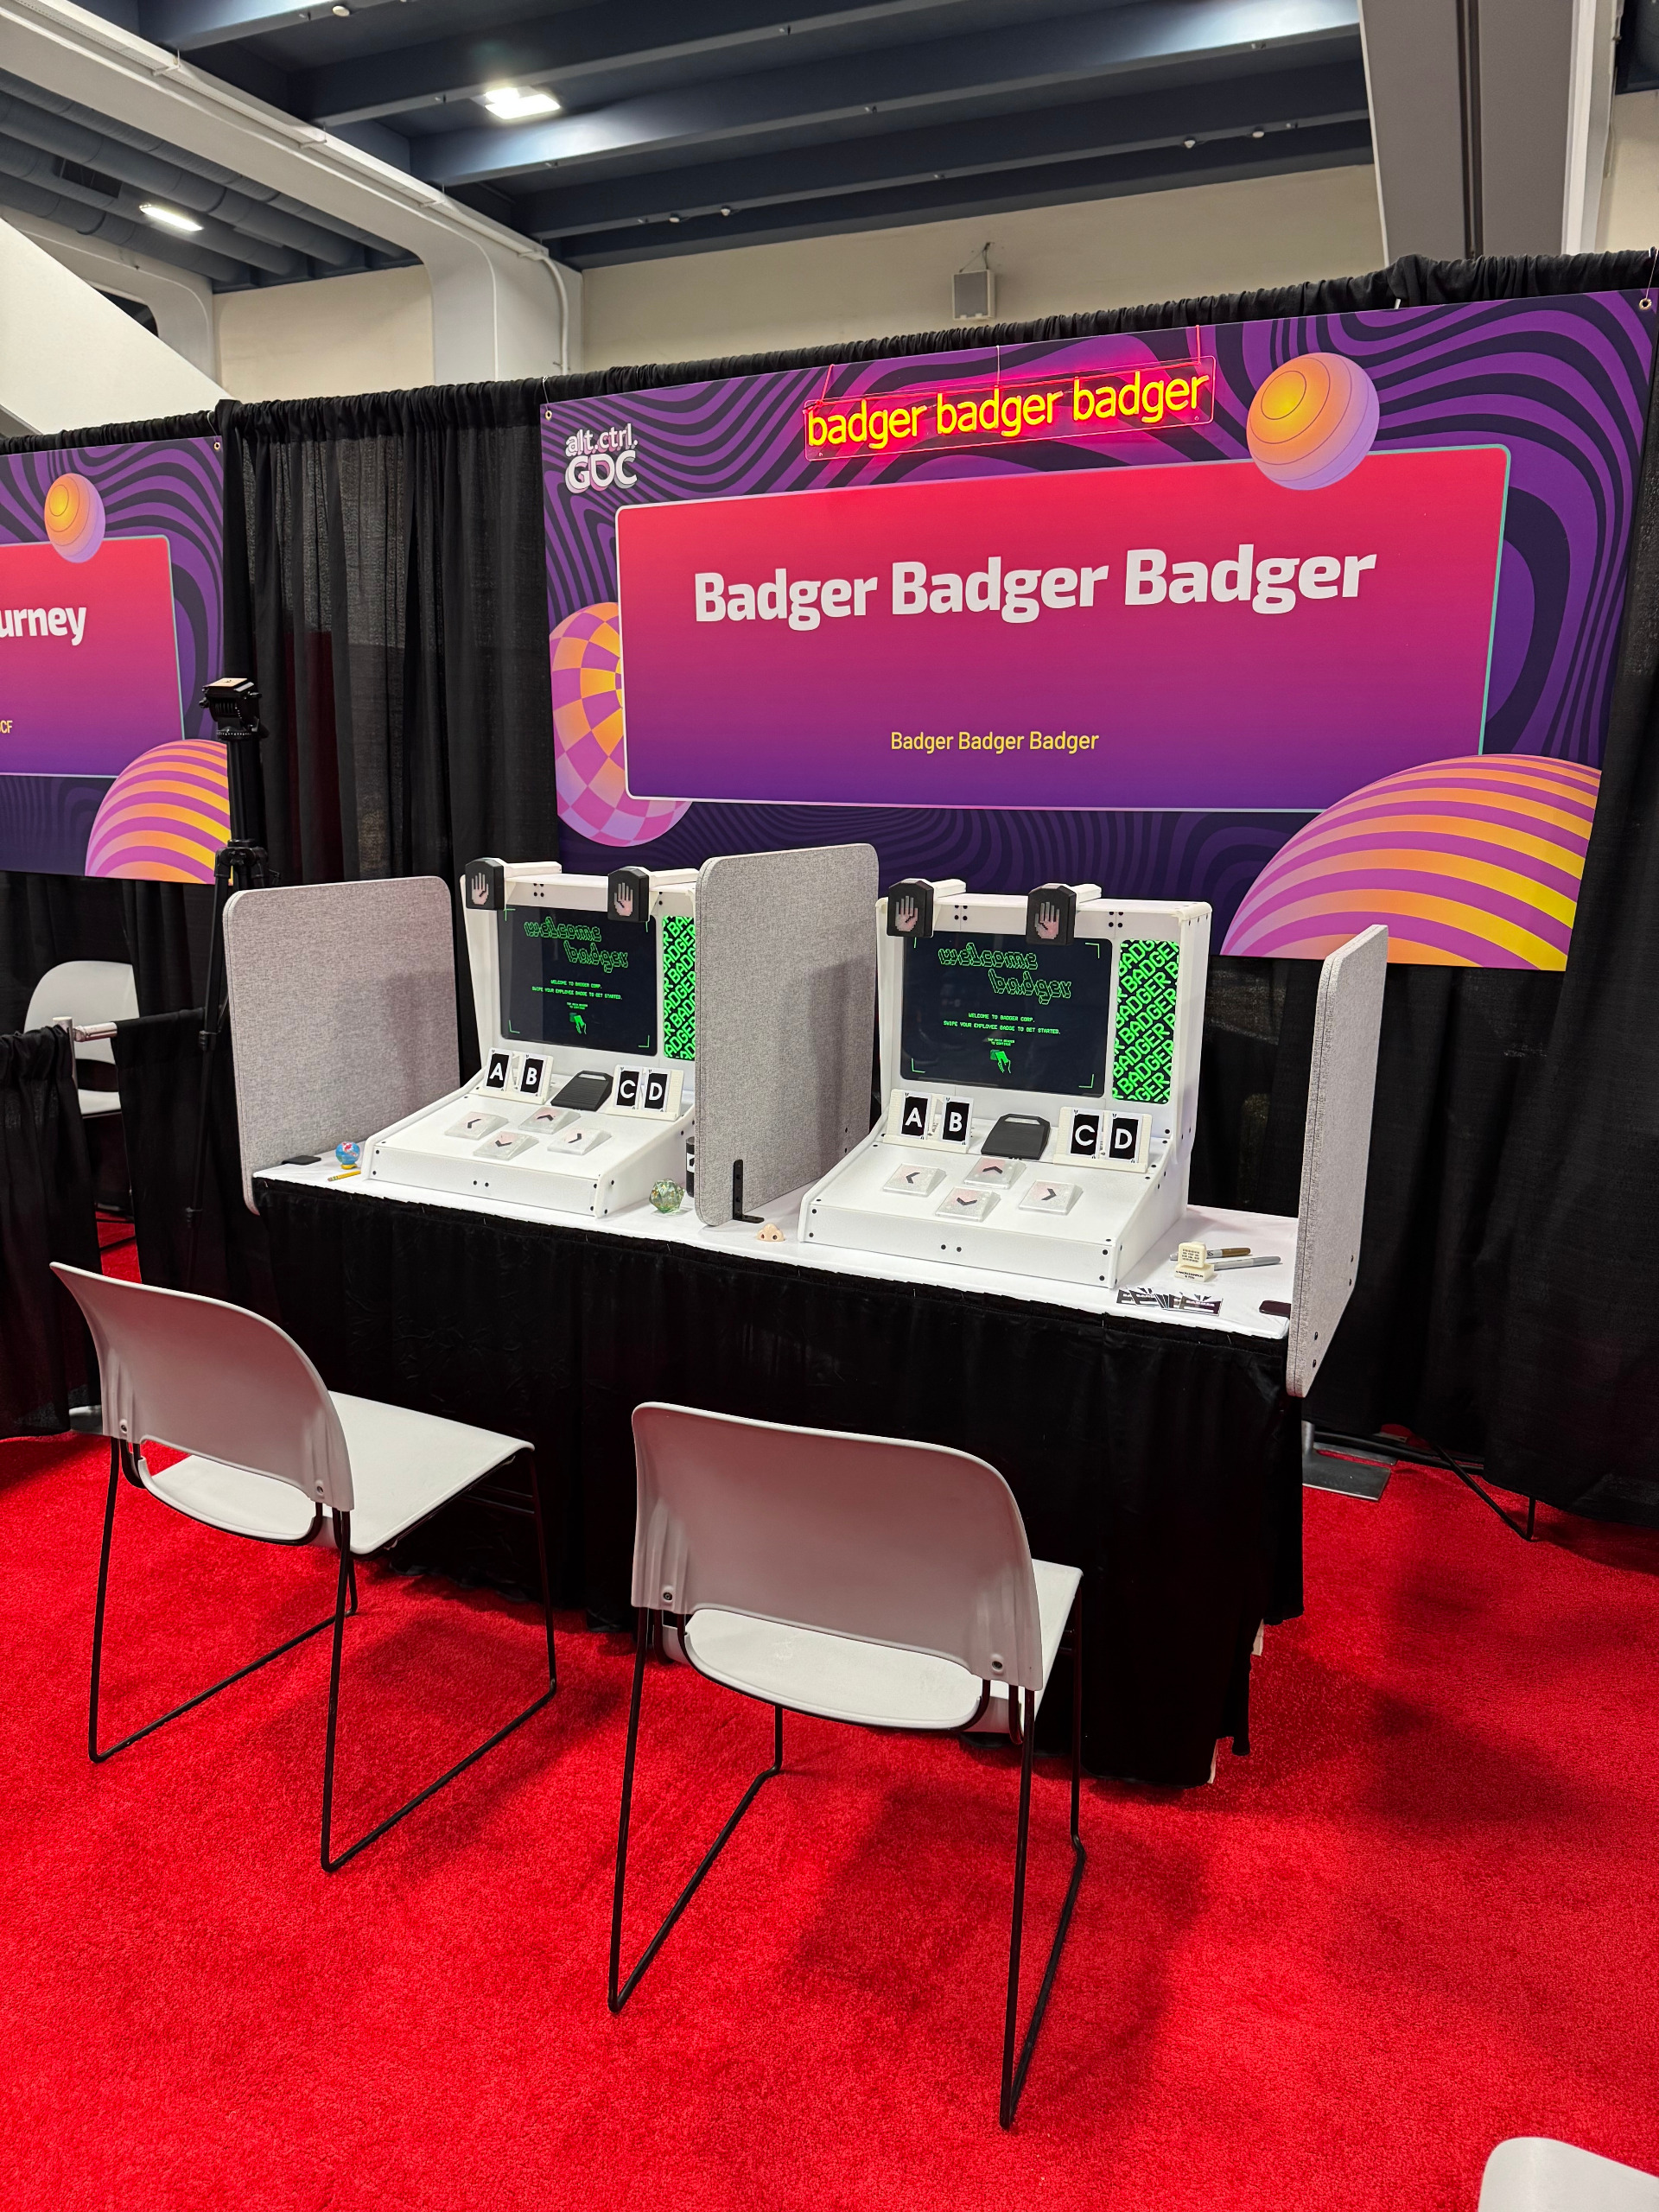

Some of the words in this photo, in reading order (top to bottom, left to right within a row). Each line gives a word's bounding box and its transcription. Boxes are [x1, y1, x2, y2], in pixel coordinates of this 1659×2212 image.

[809, 399, 927, 449] badger
[938, 386, 1063, 436] badger
[1074, 372, 1210, 422] badger
[565, 423, 638, 456] alt.ctrl.
[565, 450, 638, 493] GDC
[695, 568, 878, 632] Badger
[892, 556, 1109, 624] Badger
[1124, 543, 1377, 614] Badger
[0, 721, 13, 734] CF
[891, 731, 952, 754] Badger
[958, 731, 1023, 754] Badger
[1029, 731, 1099, 754] Badger
[524, 916, 602, 943] welcome
[563, 940, 629, 973] badger
[938, 942, 1038, 969] welcome
[988, 969, 1071, 1005] badger
[1118, 988, 1176, 1045] BADGER
[664, 1016, 696, 1058] ADGER
[1113, 1023, 1170, 1078] BADGER
[489, 1062, 504, 1081] A
[525, 1067, 537, 1085] B
[620, 1079, 636, 1099] C
[648, 1082, 663, 1100] D
[1117, 1039, 1173, 1095] BADGER
[905, 1107, 923, 1128] A
[949, 1112, 963, 1132] B
[1075, 1124, 1096, 1147] C
[1114, 1128, 1133, 1149] D
